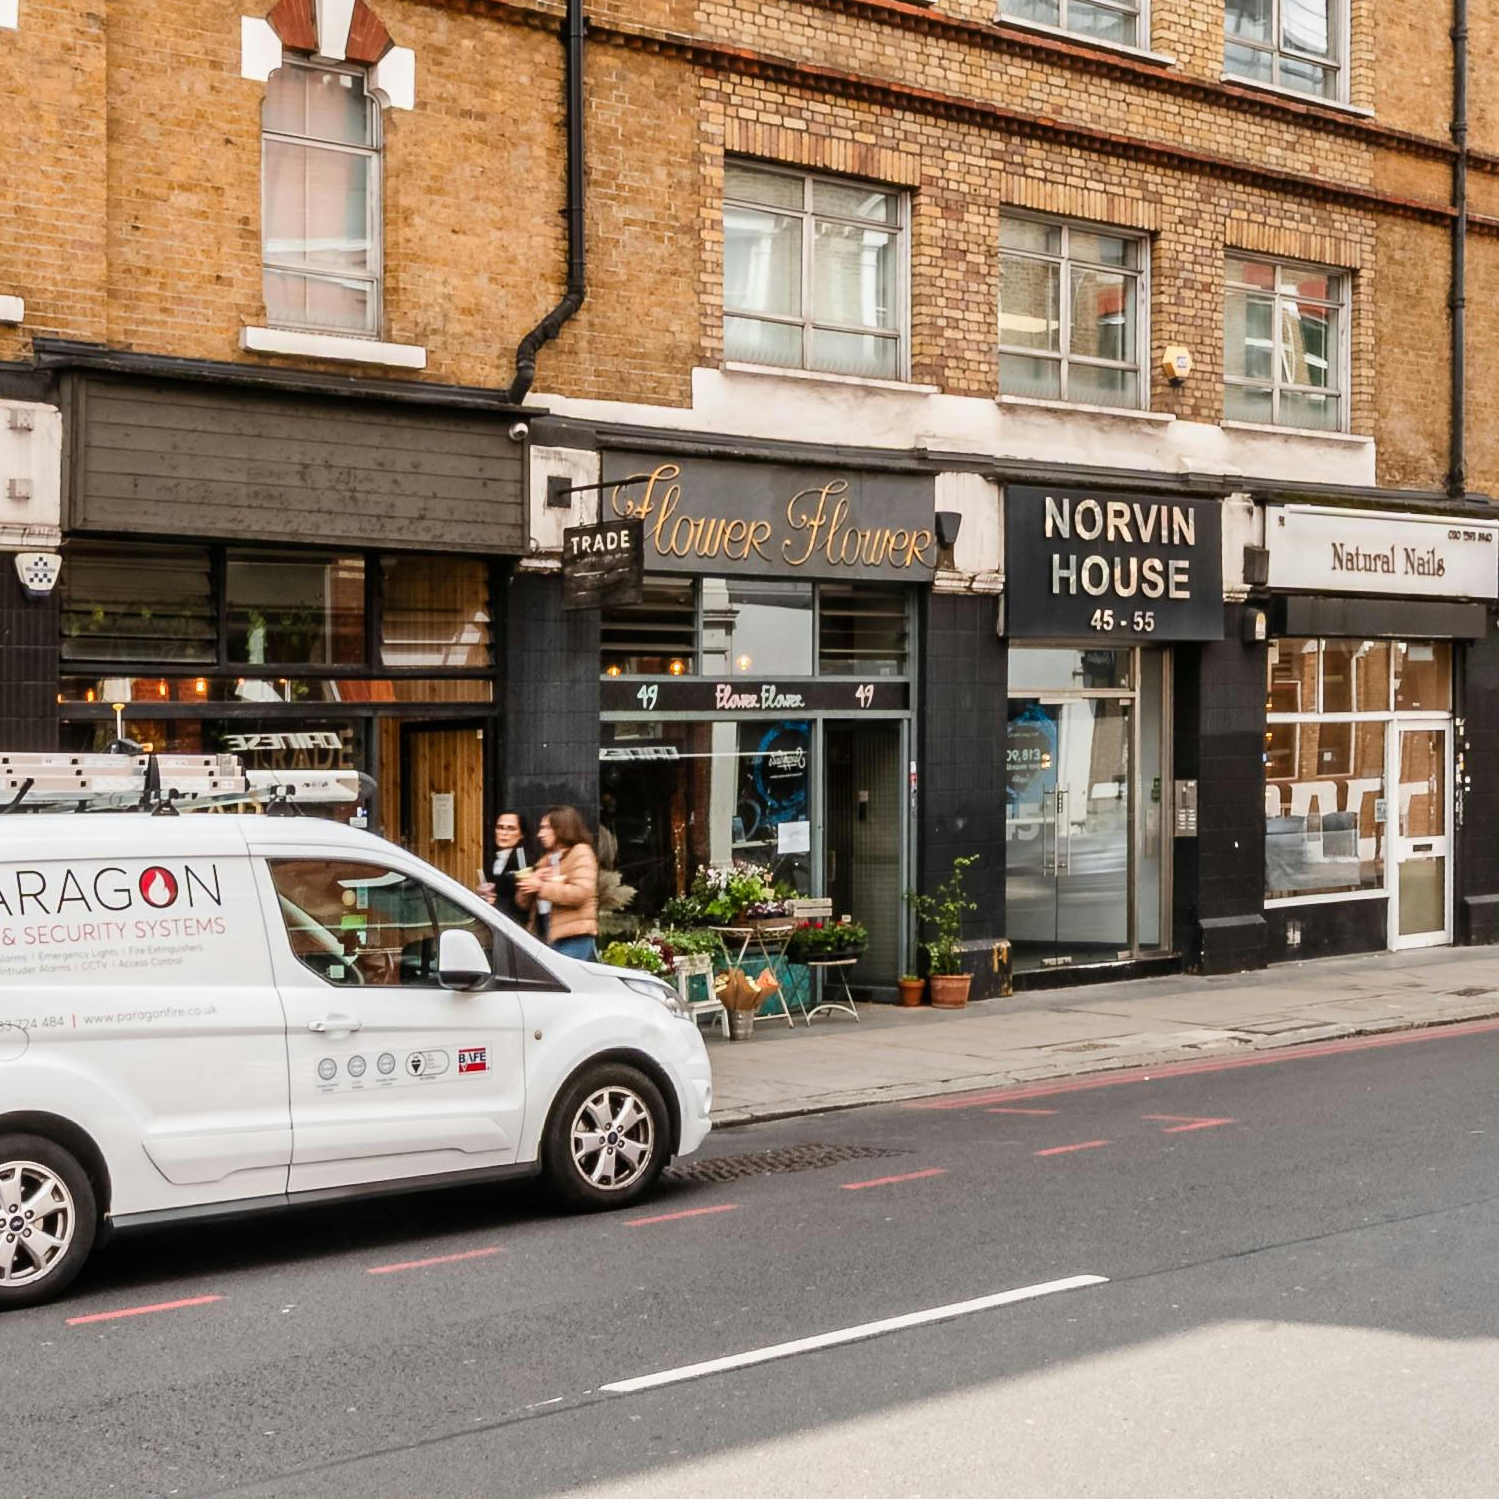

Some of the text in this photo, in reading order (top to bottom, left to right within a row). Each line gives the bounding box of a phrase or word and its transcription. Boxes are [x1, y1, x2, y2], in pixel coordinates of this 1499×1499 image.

[1045, 496, 1196, 546] NORVIN
[570, 530, 630, 554] TRADE
[1331, 542, 1446, 577] Natural Nails
[1052, 553, 1191, 599] HOUSE
[1090, 608, 1114, 631] 45
[1133, 611, 1155, 632] 55
[637, 684, 658, 711] 49
[855, 684, 875, 709] 49
[2, 927, 16, 946] &
[24, 921, 127, 945] SECURITY
[134, 916, 226, 939] SYSTEMS
[38, 951, 88, 962] Emergency
[92, 949, 119, 958] Lights
[129, 946, 146, 955] Fire
[147, 944, 203, 955] Extinguishers
[0, 957, 183, 975] Intruder Alarms CCTV Access Control
[42, 1015, 64, 1028] 484
[83, 1004, 218, 1025] www.paragonfire.co.uk
